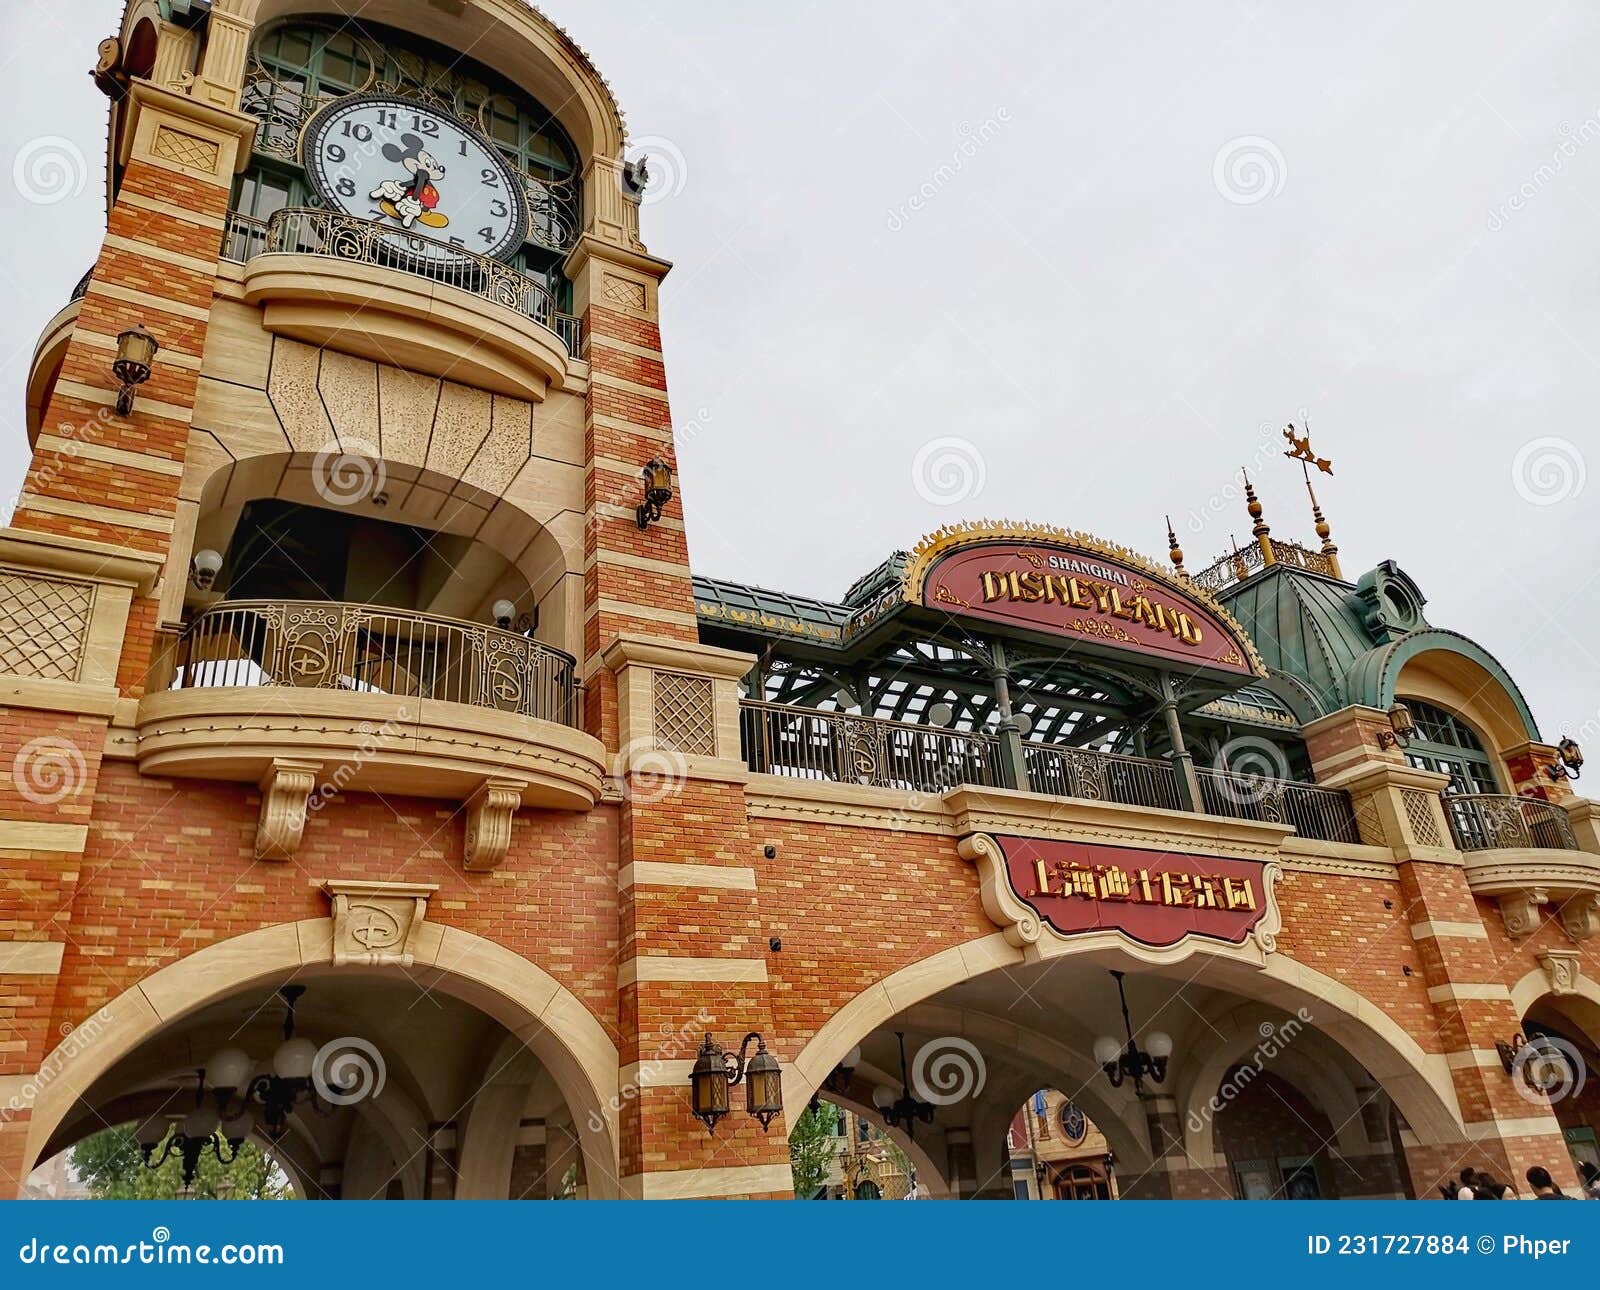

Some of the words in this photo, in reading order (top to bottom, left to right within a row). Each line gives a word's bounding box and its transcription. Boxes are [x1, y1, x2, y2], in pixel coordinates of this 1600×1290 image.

[377, 109, 397, 130] 11
[411, 115, 440, 139] 12
[341, 120, 373, 142] 10
[326, 144, 346, 163] 9
[458, 140, 468, 157] 1
[336, 177, 356, 198] 8
[481, 168, 499, 188] 2
[490, 200, 508, 218] 3
[477, 226, 496, 244] 4
[1047, 555, 1129, 587] SHANGHAI
[980, 570, 1204, 646] DISNEYLAND
